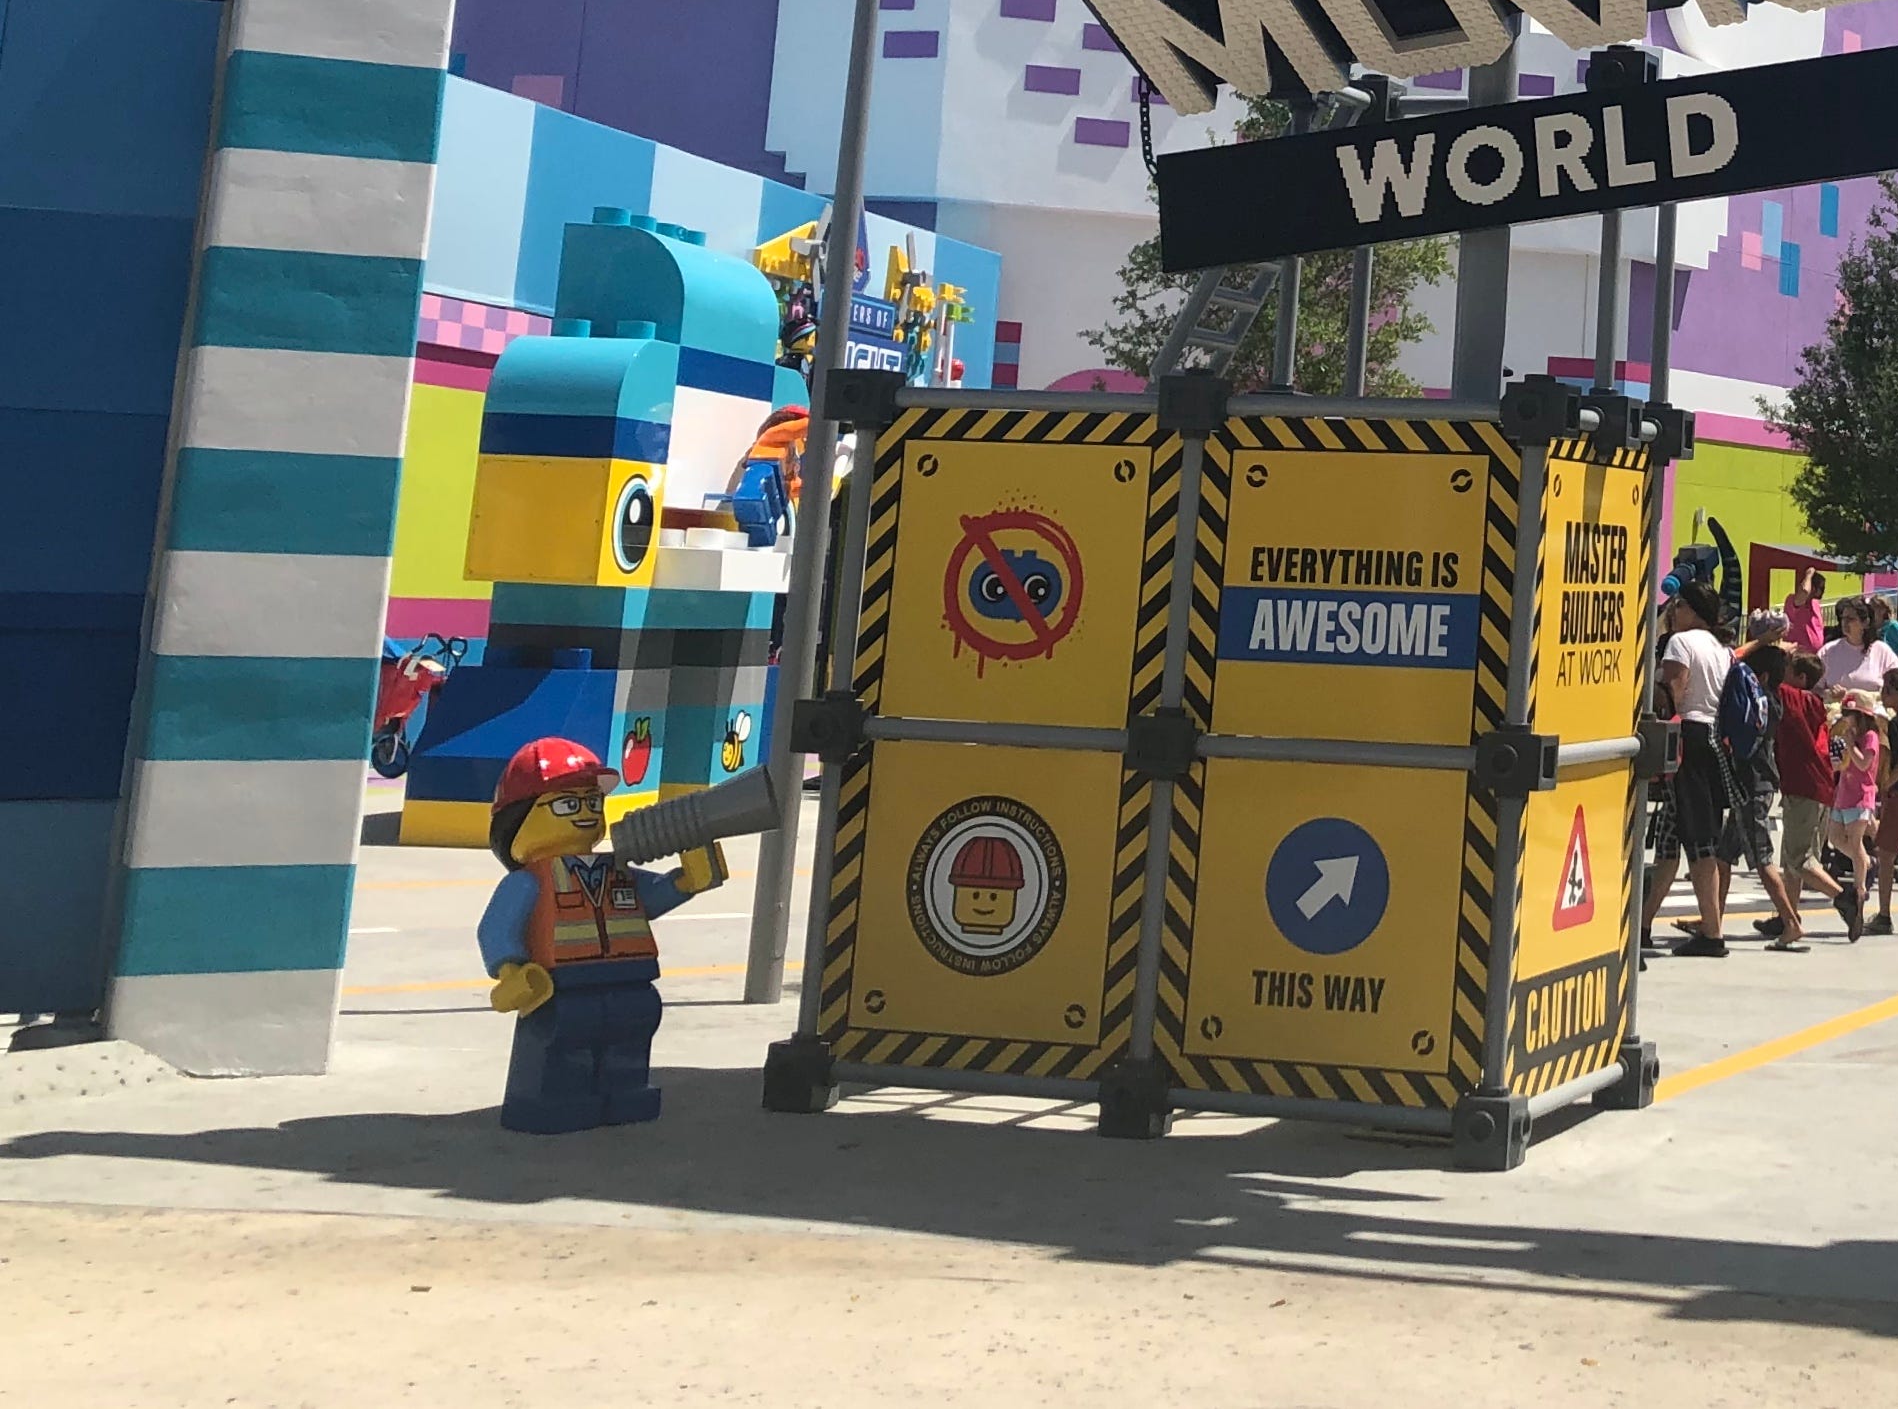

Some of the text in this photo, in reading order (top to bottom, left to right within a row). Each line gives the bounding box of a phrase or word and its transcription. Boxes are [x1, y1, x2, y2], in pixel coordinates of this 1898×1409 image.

[1336, 92, 1739, 224] WORLD
[850, 303, 889, 329] ERS OF
[1250, 546, 1459, 588] EVERYTHING IS
[1563, 521, 1628, 585] MASTER
[1249, 598, 1451, 657] AWESOME
[1559, 590, 1625, 645] BUILDERS
[1556, 648, 1623, 688] AT WORK
[912, 801, 1062, 881] ALWAYS FOLLOW INSTRUCTIONS
[911, 892, 1062, 971] ALWAYS FOLLOW INSTRUCTIONS
[1252, 969, 1386, 1014] THIS WAY
[1525, 966, 1607, 1054] CAUTION
